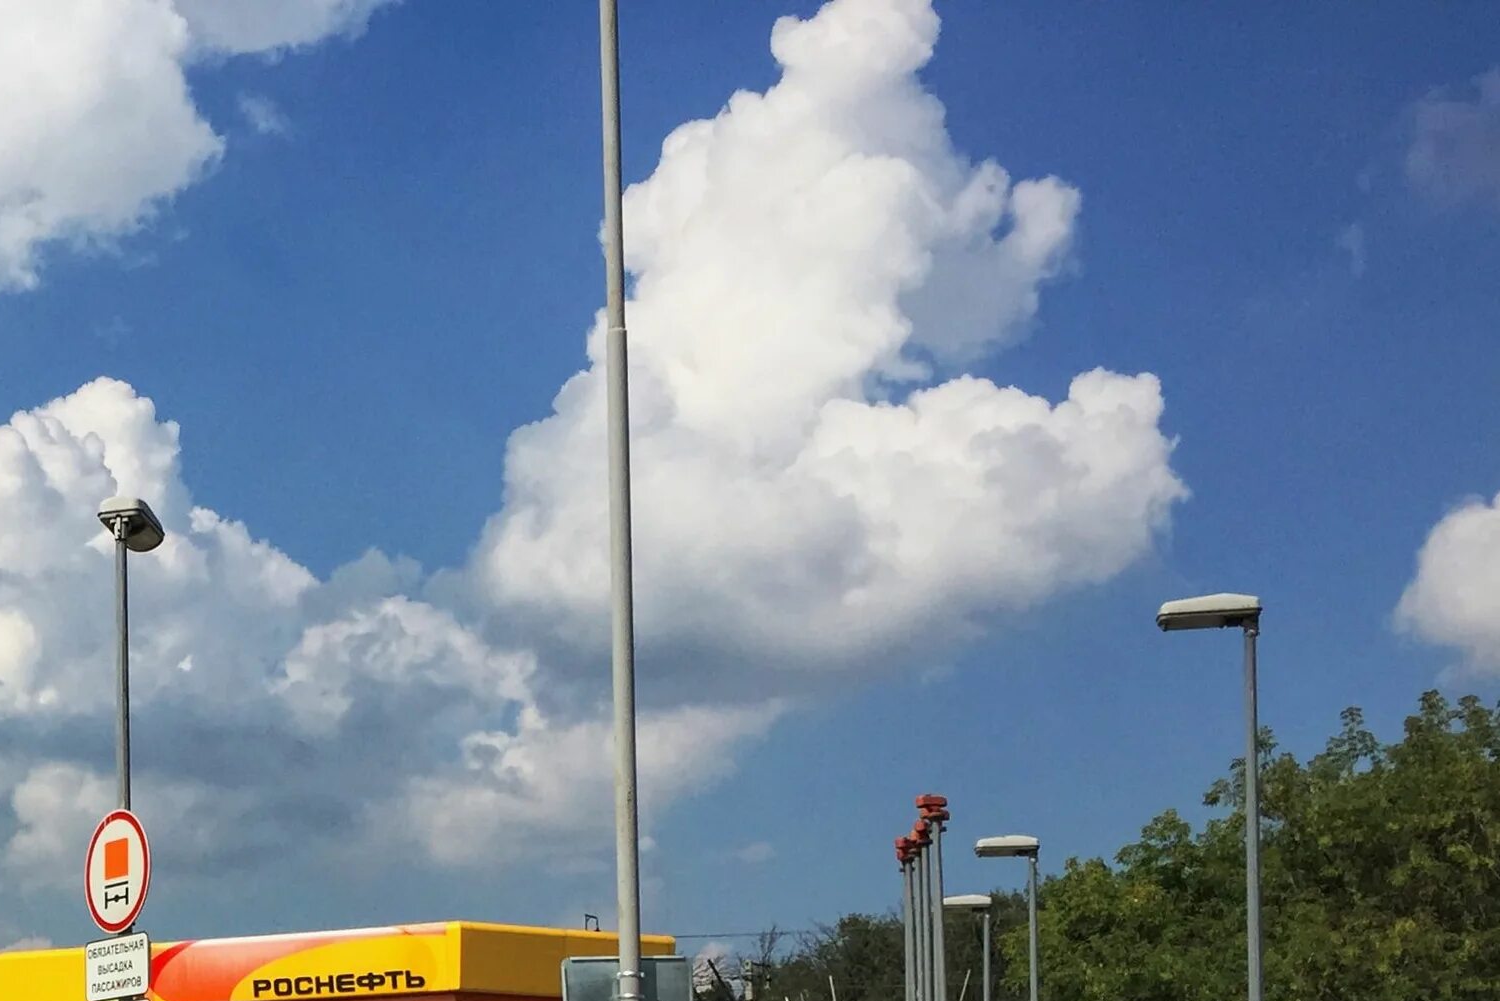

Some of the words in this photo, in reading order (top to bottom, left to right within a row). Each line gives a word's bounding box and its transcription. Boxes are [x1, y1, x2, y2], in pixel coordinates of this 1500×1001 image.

[87, 938, 145, 960] ОБЯЗАТЕЛЬНАЯ
[97, 959, 133, 976] ВЫСАДКА
[91, 975, 142, 994] ПАССАЖИРОВ
[252, 970, 426, 998] РОСНЕФТЬ
